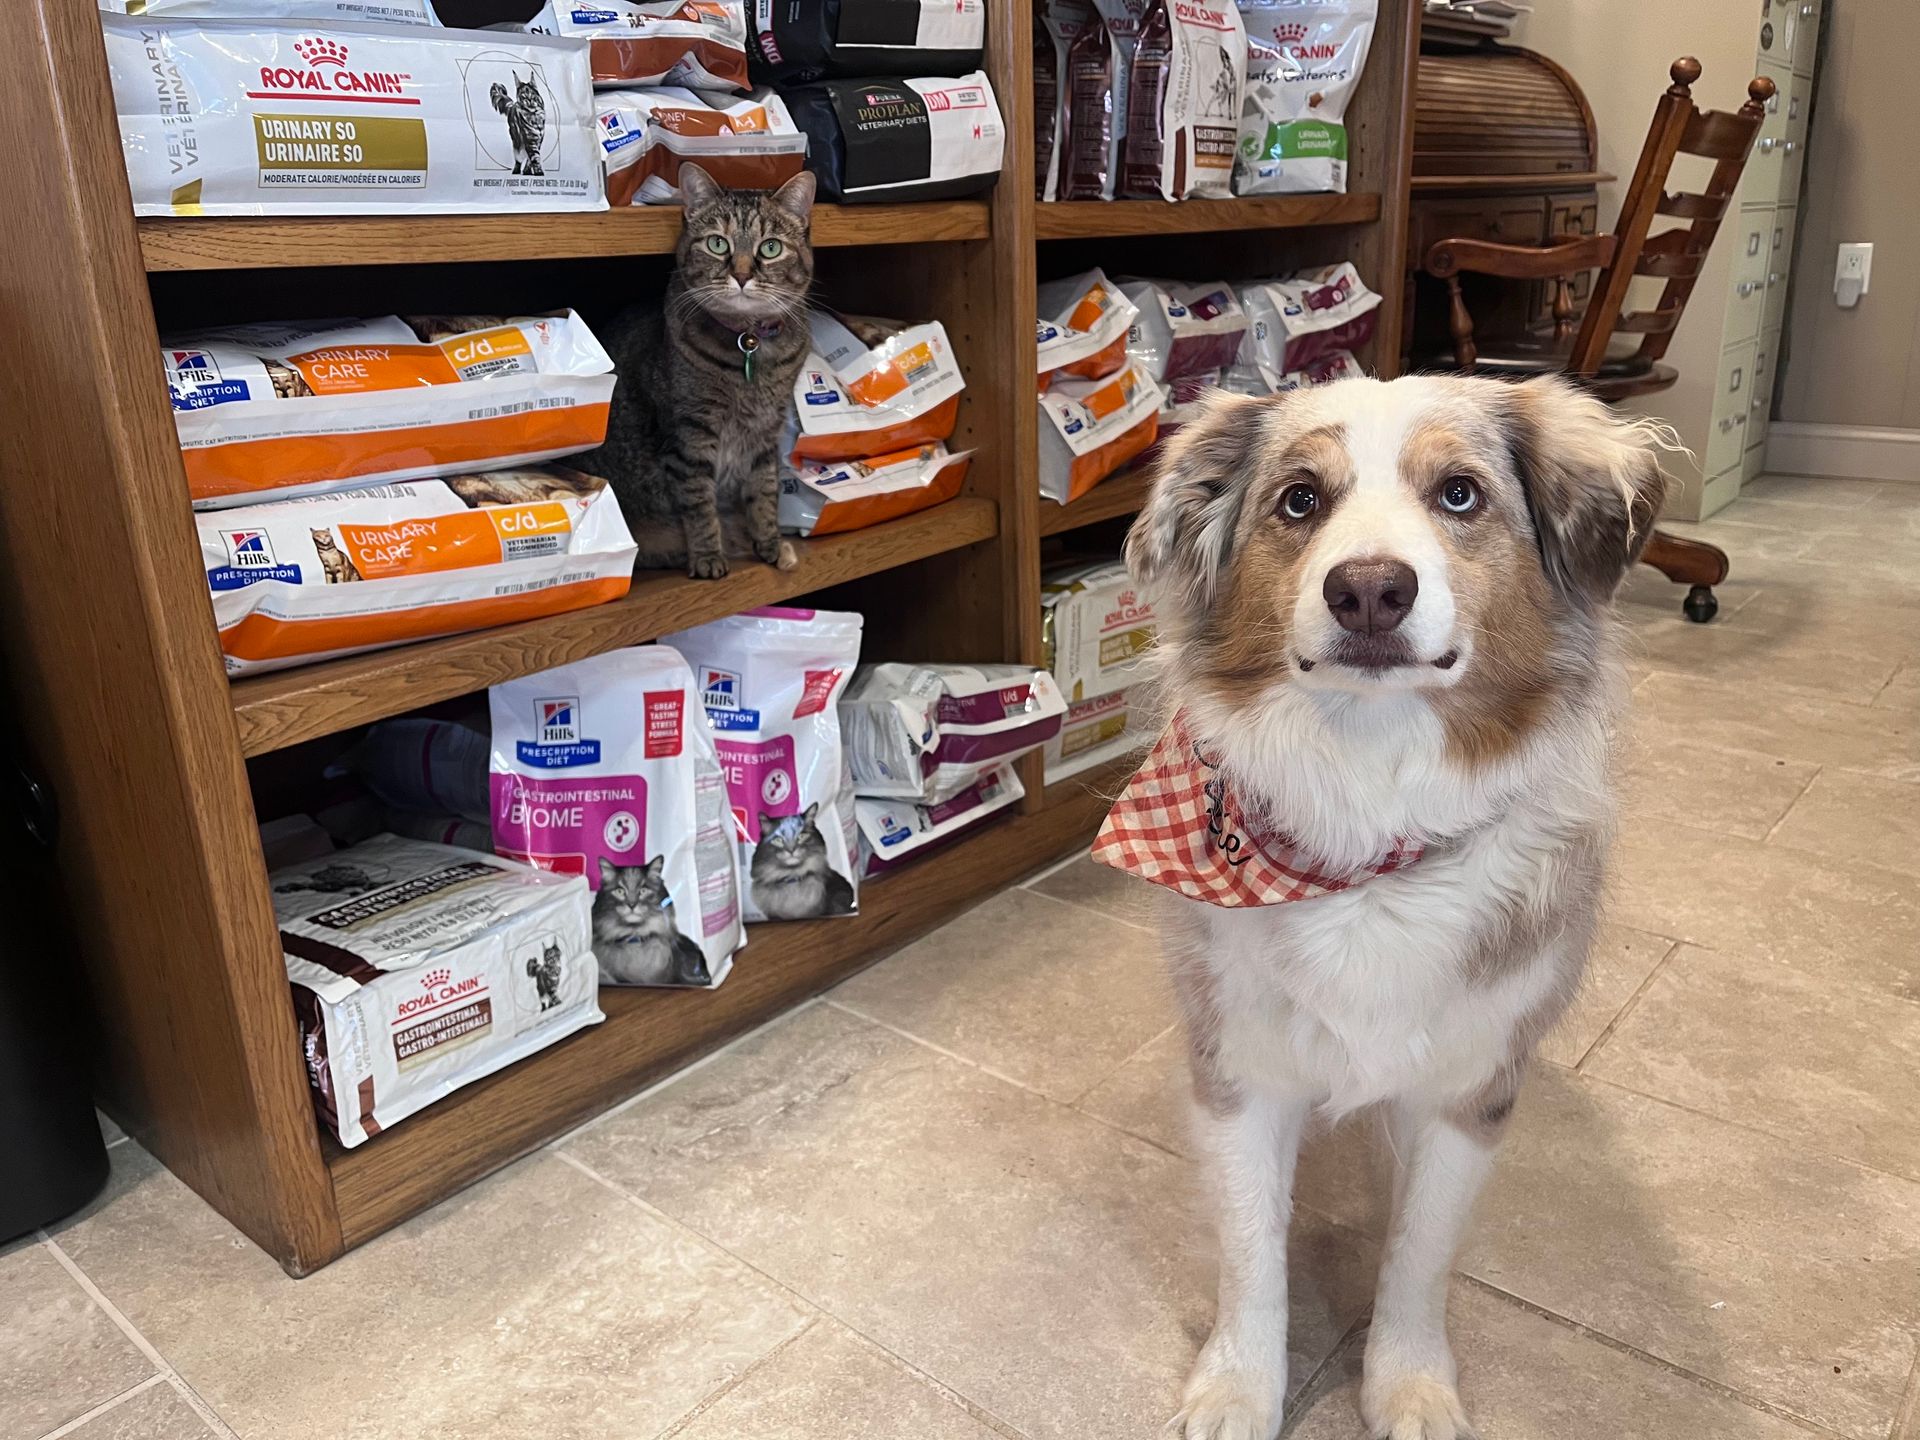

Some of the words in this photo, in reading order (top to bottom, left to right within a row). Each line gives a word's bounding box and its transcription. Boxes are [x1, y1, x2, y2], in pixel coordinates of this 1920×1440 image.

[1291, 46, 1335, 59] CANIN
[260, 67, 331, 90] ROYAL
[334, 71, 402, 93] CANIN
[928, 91, 948, 111] DM
[858, 104, 885, 121] PRO
[887, 103, 920, 118] PLAN
[261, 119, 332, 139] URINARY
[335, 121, 356, 140] SO
[857, 118, 905, 131] VETERINARY
[906, 115, 928, 125] DIETS
[606, 133, 640, 148] PRESCRIPTION
[265, 143, 340, 162] URINAIRE
[343, 144, 363, 163] SO
[264, 174, 306, 183] MODERATE
[308, 172, 377, 184] CALORIE/MODÉRÉE
[389, 175, 421, 184] CALORIES
[301, 349, 390, 363] URINARY
[454, 338, 494, 362] c/d
[311, 363, 369, 379] CARE
[463, 358, 517, 374] VETERINARIAN
[179, 369, 215, 383] Hill's
[190, 396, 215, 408] DIET
[501, 511, 538, 532] c/d
[351, 521, 437, 546] URINARY
[506, 536, 557, 546] VETERINARIAN
[360, 545, 413, 563] CARE
[508, 542, 558, 553] RECOMMENDED
[237, 553, 271, 566] Hill's
[216, 569, 295, 581] PRESCRIPTION
[654, 701, 677, 711] GREAT
[704, 692, 735, 707] Hill's
[650, 710, 679, 720] TASTING
[544, 727, 574, 741] Hill's
[522, 745, 595, 758] PRESCRIPTION
[716, 748, 785, 765] OINTESTINAL
[547, 756, 570, 766] DIET
[513, 787, 636, 803] GASTROINTESTINAL
[511, 804, 584, 828] BIOME
[398, 993, 438, 1015] ROYAL
[440, 976, 478, 999] CANIN
[397, 1005, 480, 1045] GASTROINTESTINAL
[398, 1012, 489, 1058] GASTRO-INTESTINALE
